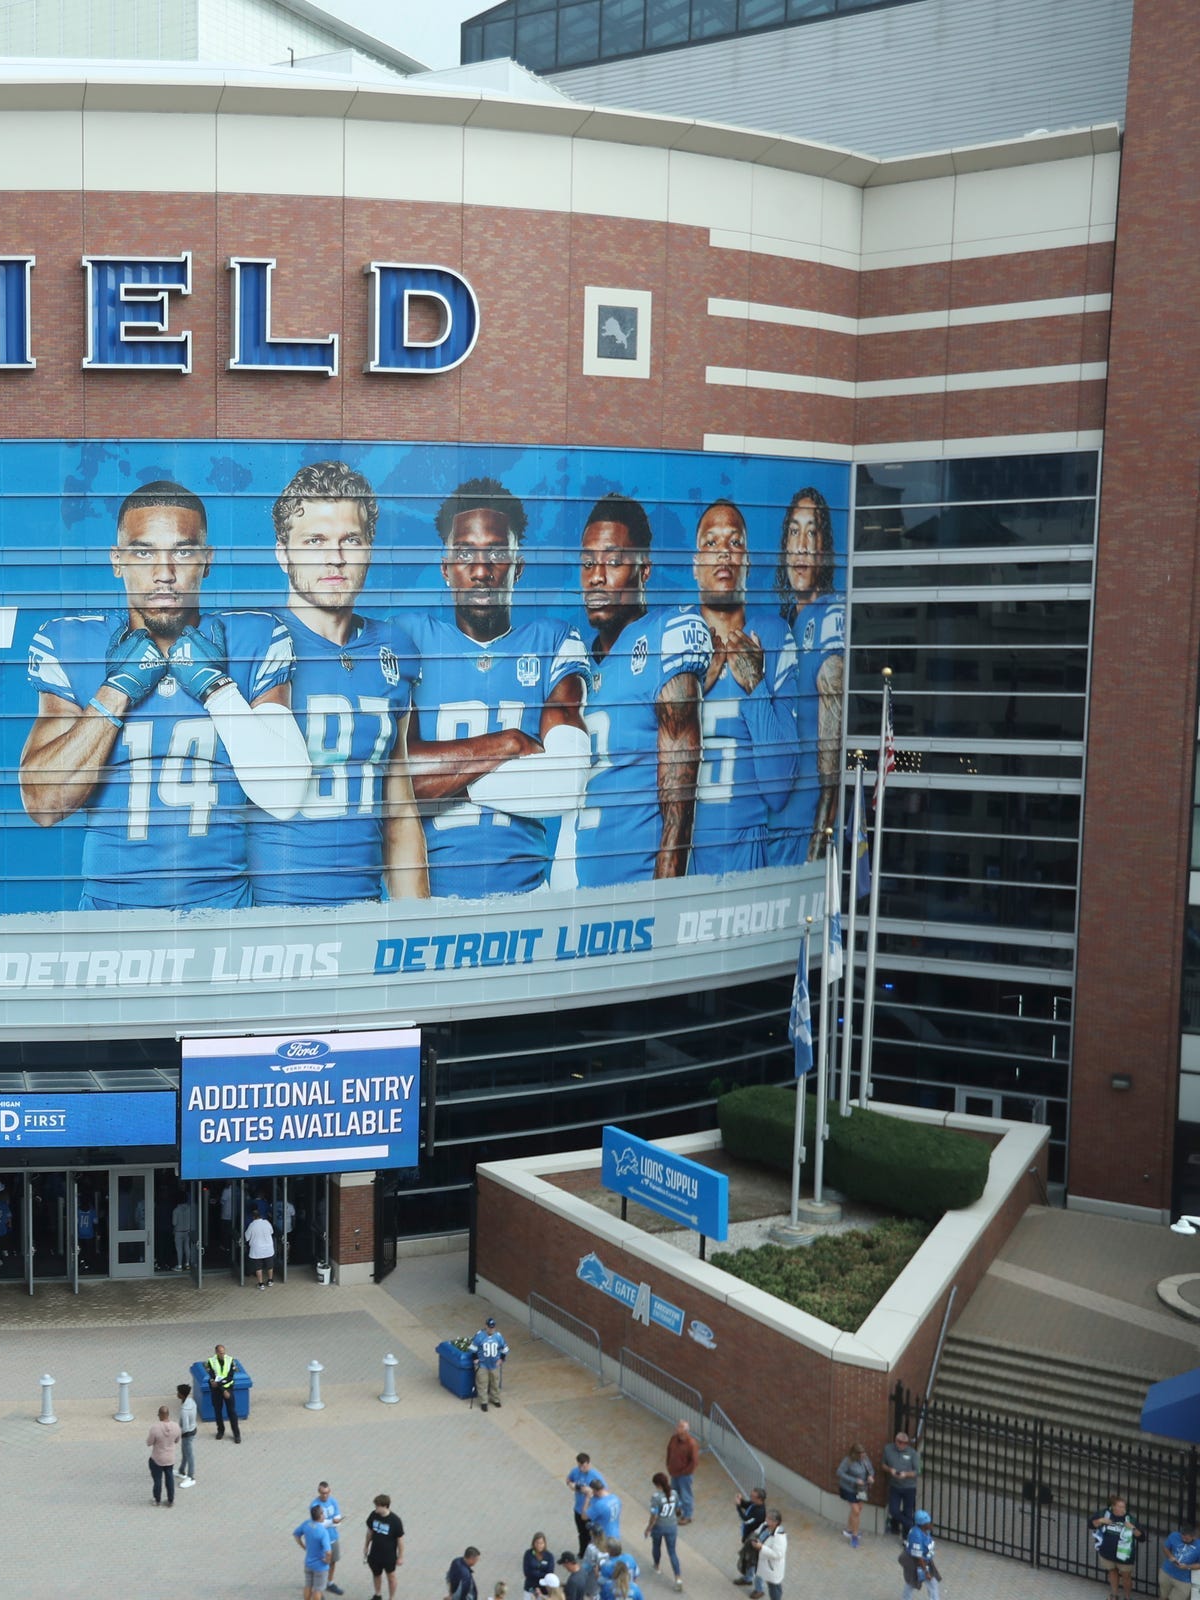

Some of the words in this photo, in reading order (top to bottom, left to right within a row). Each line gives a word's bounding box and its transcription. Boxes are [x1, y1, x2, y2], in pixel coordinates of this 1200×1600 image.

[122, 717, 218, 841] 14
[676, 895, 791, 945] DETROIT
[209, 942, 343, 985] LIONS
[373, 928, 544, 976] DETROIT
[555, 917, 655, 961] LIONS
[286, 1040, 320, 1057] Ford
[188, 1080, 335, 1111] ADDITIONAL
[342, 1074, 415, 1104] ENTRY
[24, 1114, 66, 1127] FIRST
[200, 1116, 274, 1144] GATES
[279, 1108, 403, 1140] AVAILABLE
[640, 1155, 663, 1184] LIONS
[666, 1168, 699, 1199] SUPPLY
[615, 1281, 637, 1302] GATE
[632, 1282, 651, 1327] A
[482, 1342, 499, 1357] 90
[660, 1502, 676, 1517] 97
